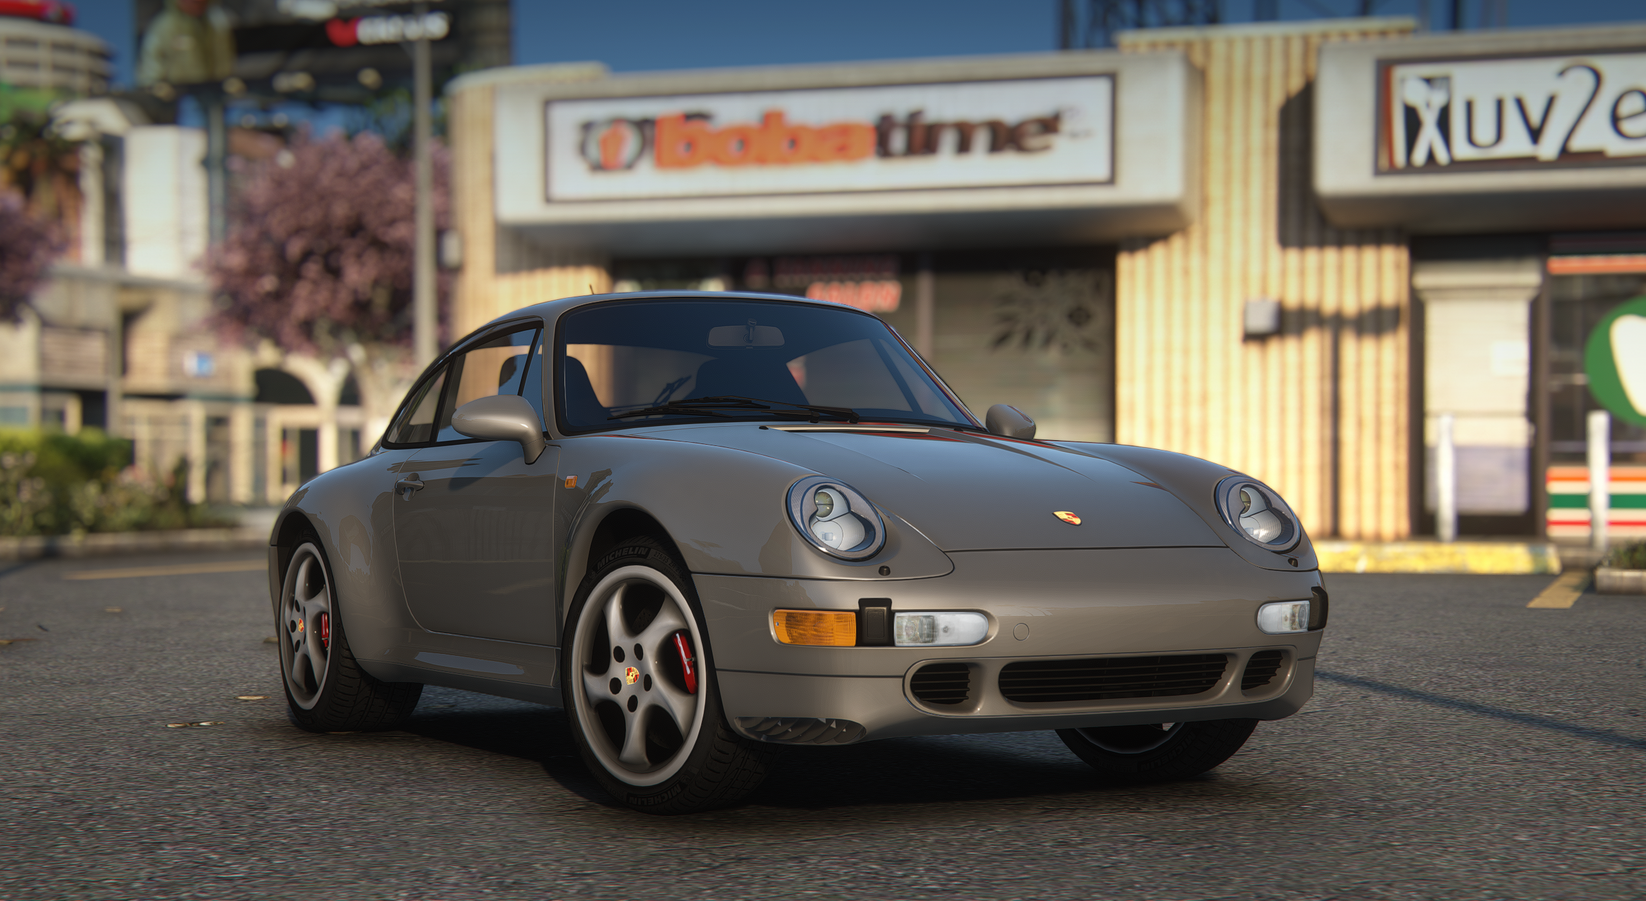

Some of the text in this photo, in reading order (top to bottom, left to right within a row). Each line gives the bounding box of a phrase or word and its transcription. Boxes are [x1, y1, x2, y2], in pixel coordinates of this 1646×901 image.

[597, 546, 648, 570] MICHELIN
[1141, 731, 1195, 772] MICHELIN
[629, 784, 682, 806] MICHELIN
